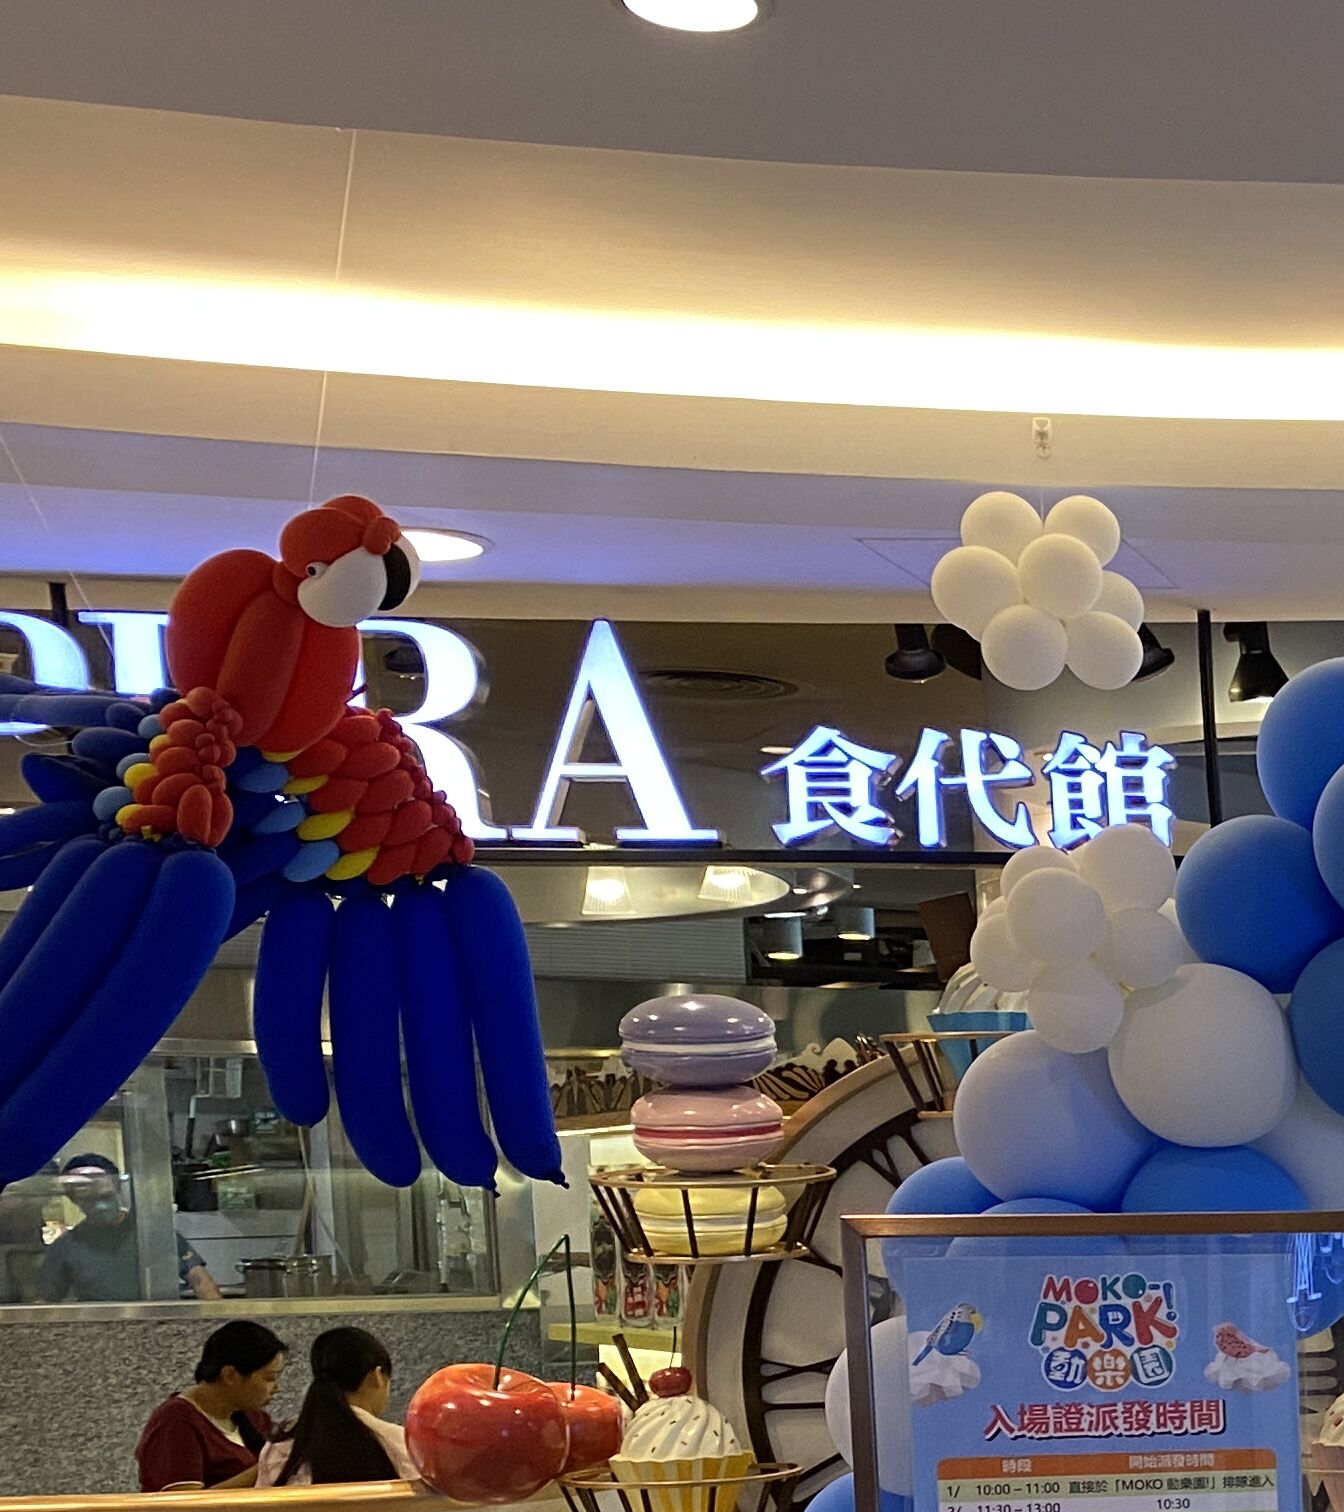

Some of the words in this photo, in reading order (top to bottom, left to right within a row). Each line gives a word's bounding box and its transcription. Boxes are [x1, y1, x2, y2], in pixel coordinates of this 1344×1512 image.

[759, 724, 1178, 851] 食代館
[1030, 1296, 1177, 1349] PARK
[1046, 1350, 1173, 1386] 動樂園
[983, 1400, 1225, 1439] 入場證派發時間
[946, 1486, 960, 1498] 1/
[976, 1484, 1011, 1496] 10:00
[1026, 1482, 1060, 1494] 11:00
[1157, 1498, 1190, 1510] 10:30
